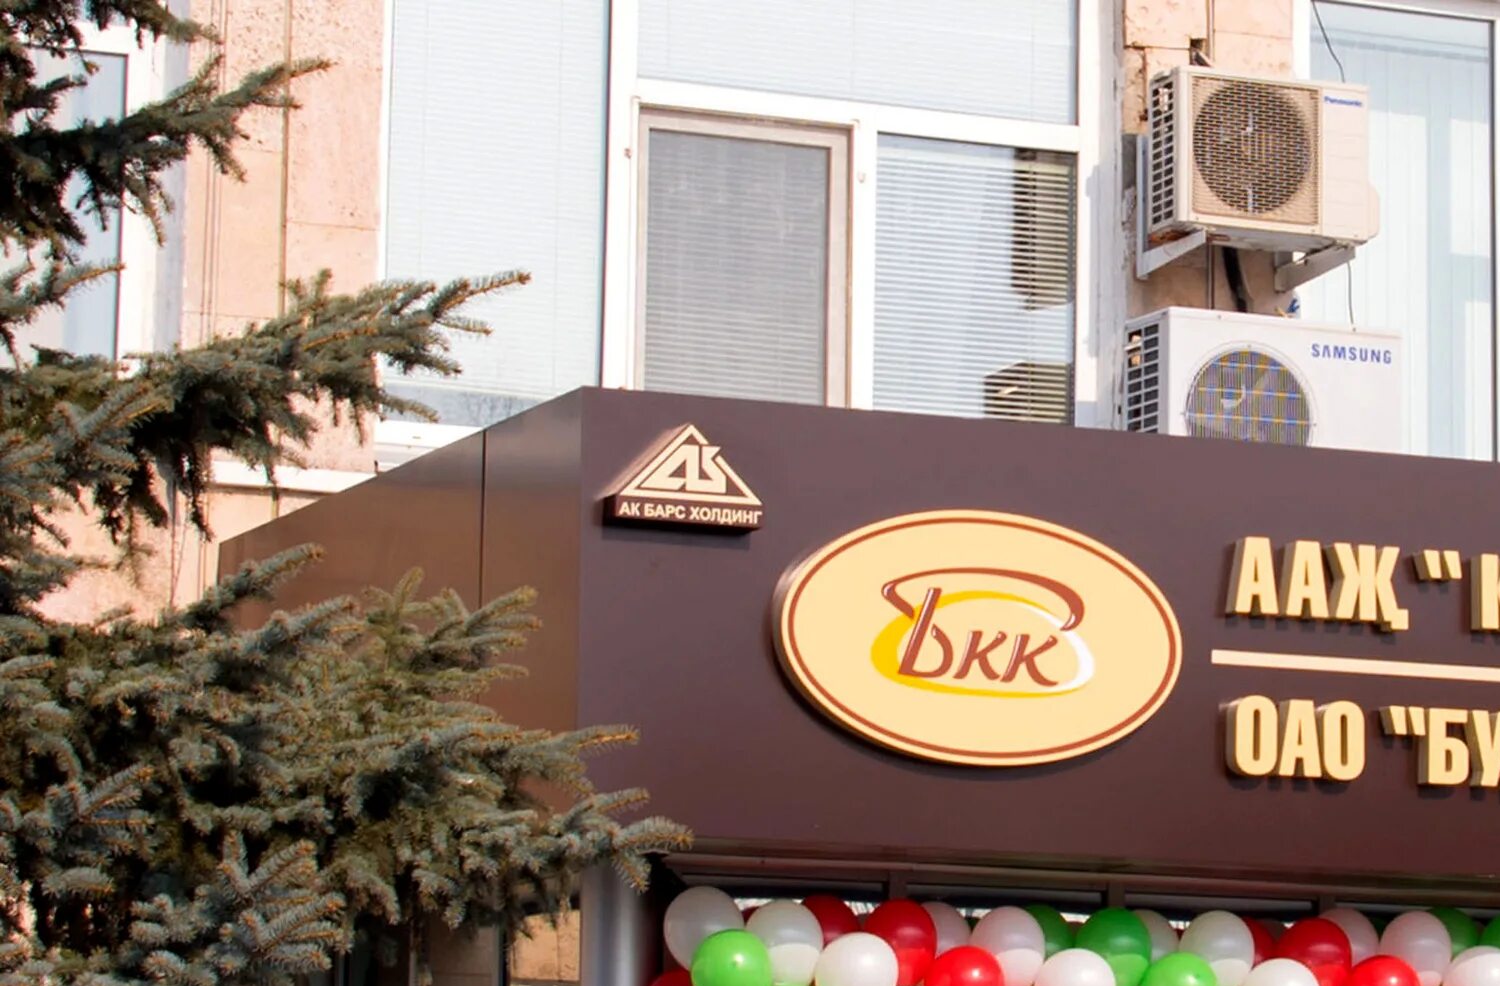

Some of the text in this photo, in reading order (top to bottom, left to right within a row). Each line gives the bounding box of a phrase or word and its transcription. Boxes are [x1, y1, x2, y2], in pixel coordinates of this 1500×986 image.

[1310, 343, 1393, 366] SAMSUNG
[618, 501, 762, 525] АК БАРС ХОЛДИНГ
[1226, 694, 1366, 782] ОАО
